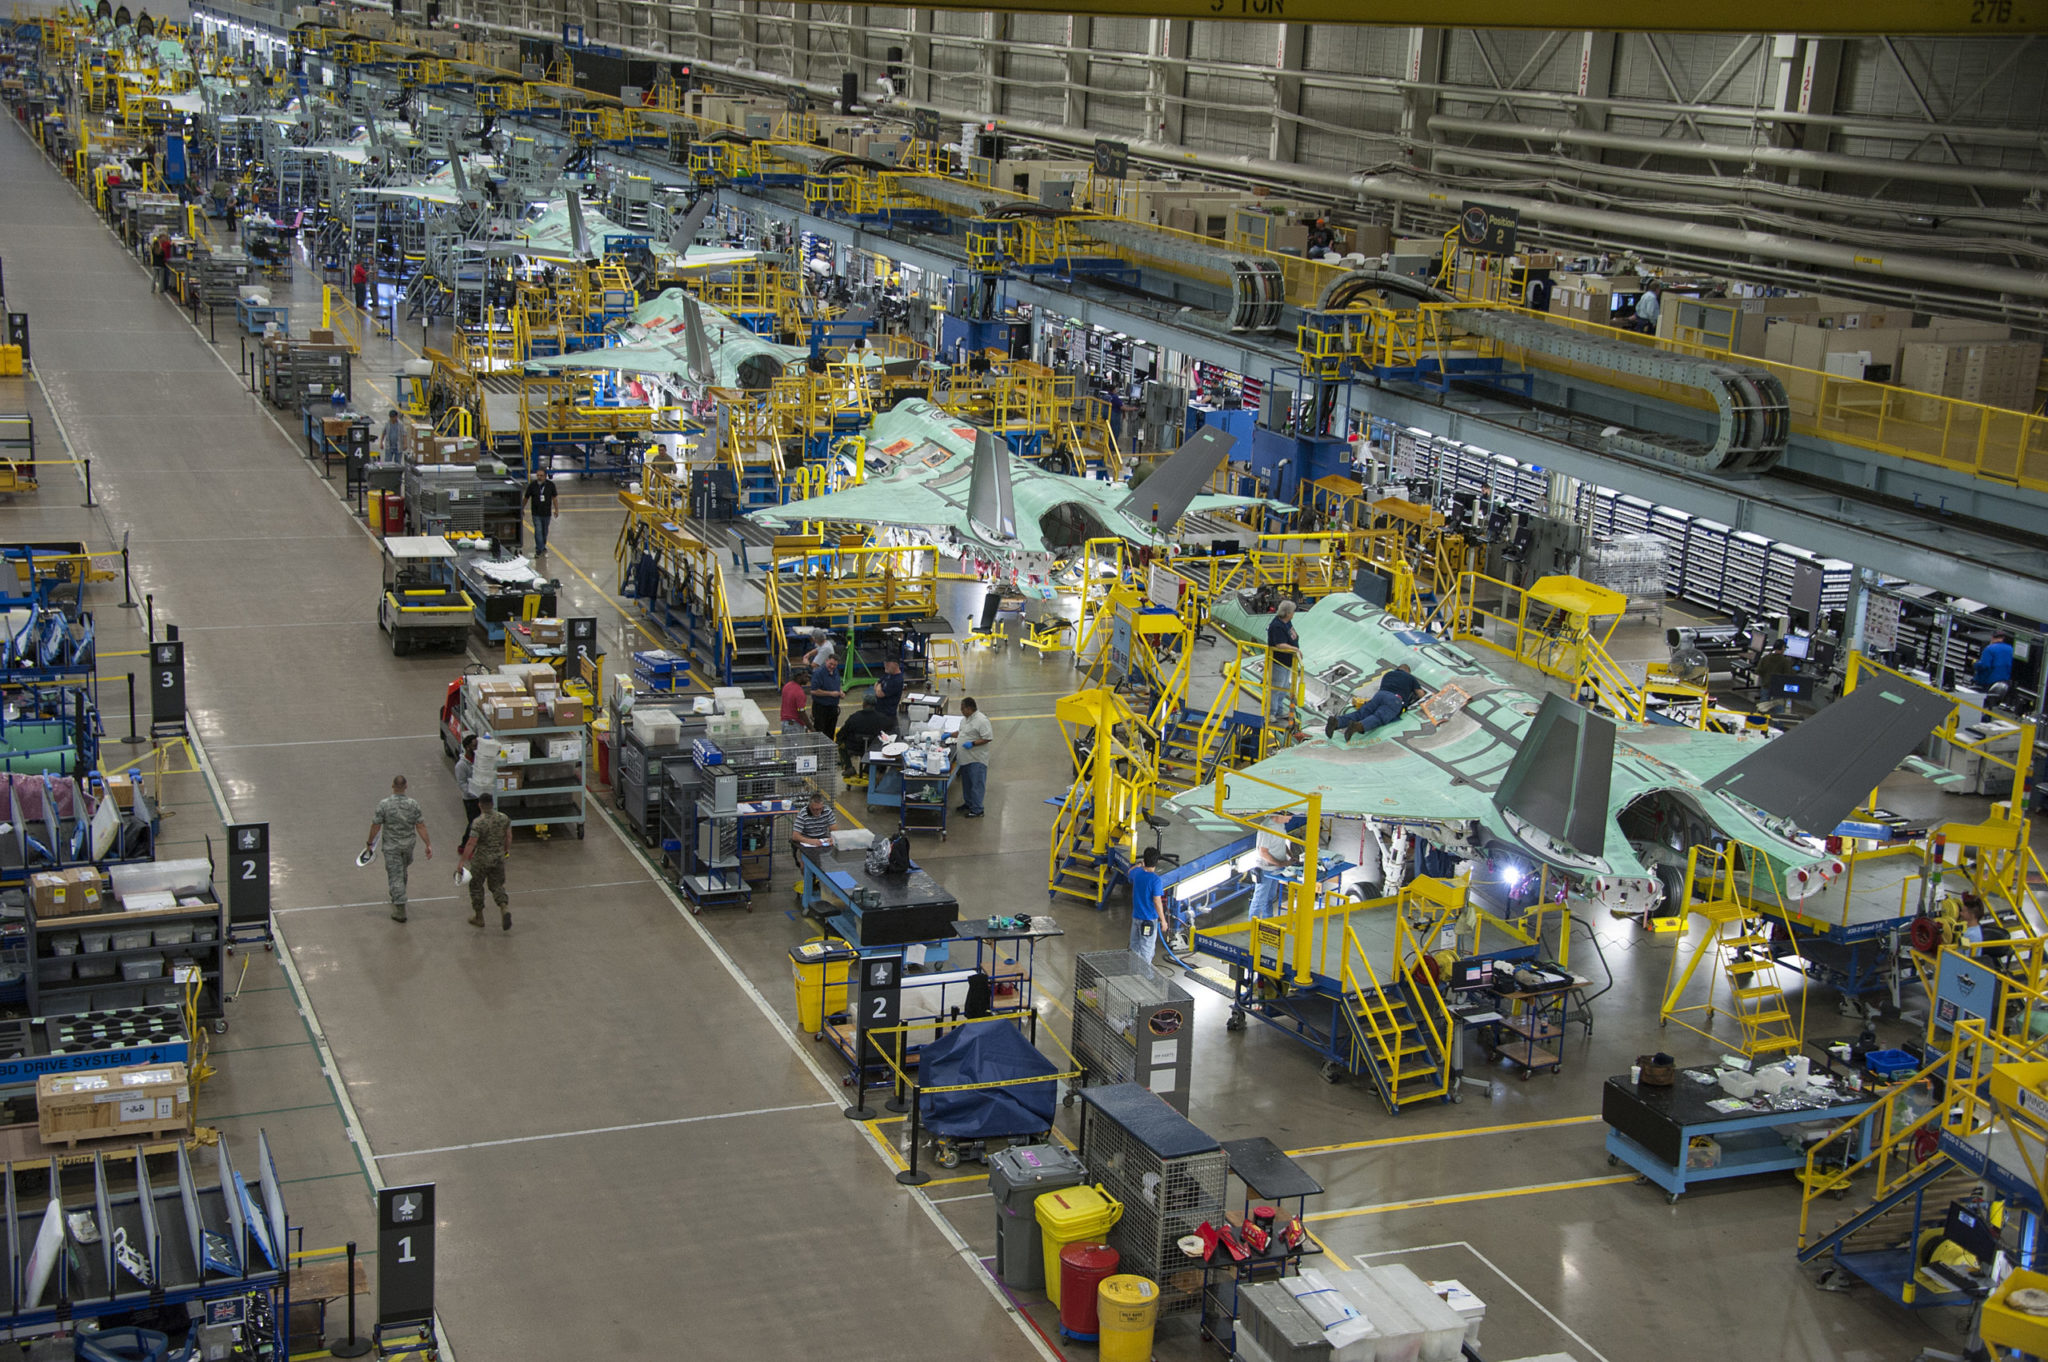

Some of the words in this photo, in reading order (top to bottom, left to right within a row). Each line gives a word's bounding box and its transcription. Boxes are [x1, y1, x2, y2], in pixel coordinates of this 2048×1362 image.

[1489, 214, 1515, 228] Position
[1496, 229, 1504, 244] 2
[15, 330, 24, 340] 4
[354, 447, 364, 459] 4
[162, 671, 174, 688] 3
[242, 860, 257, 880] 2
[872, 996, 887, 1018] 2
[24, 1059, 68, 1074] DRIVE
[74, 1052, 132, 1068] SYSTEM
[398, 1236, 416, 1263] 1
